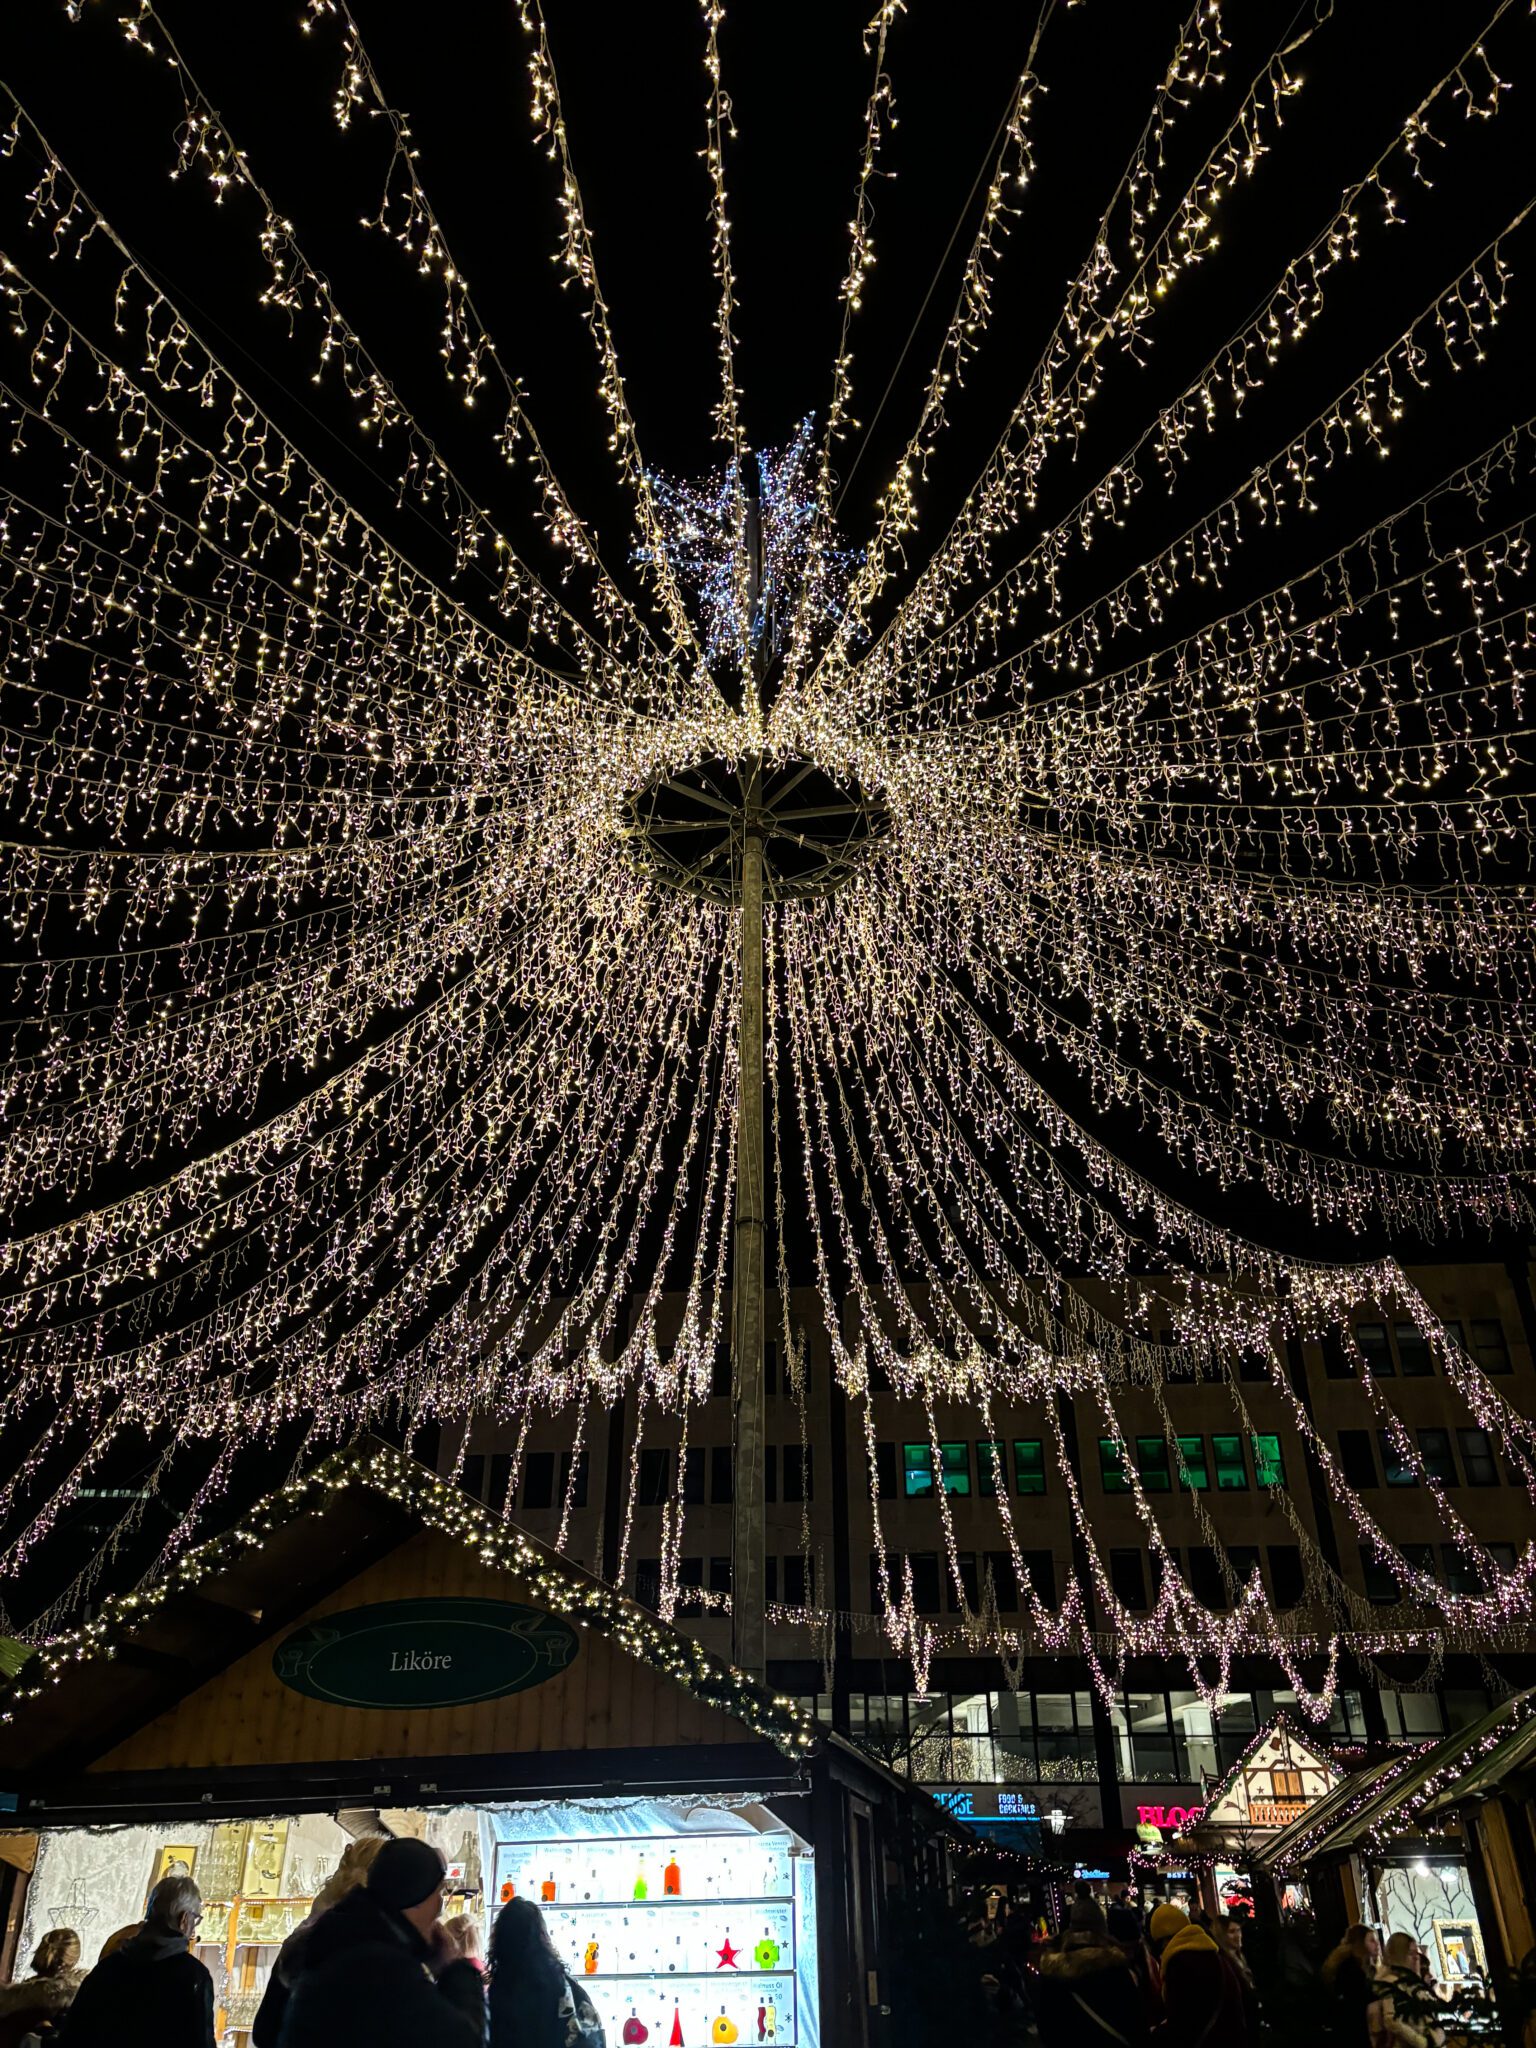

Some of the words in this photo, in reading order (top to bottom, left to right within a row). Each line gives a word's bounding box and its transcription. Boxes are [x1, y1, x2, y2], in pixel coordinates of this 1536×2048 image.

[389, 1650, 453, 1672] Liköre
[998, 1793, 1016, 1804] FOOD
[1017, 1793, 1023, 1804] &
[998, 1804, 1036, 1815] COCKTAILS
